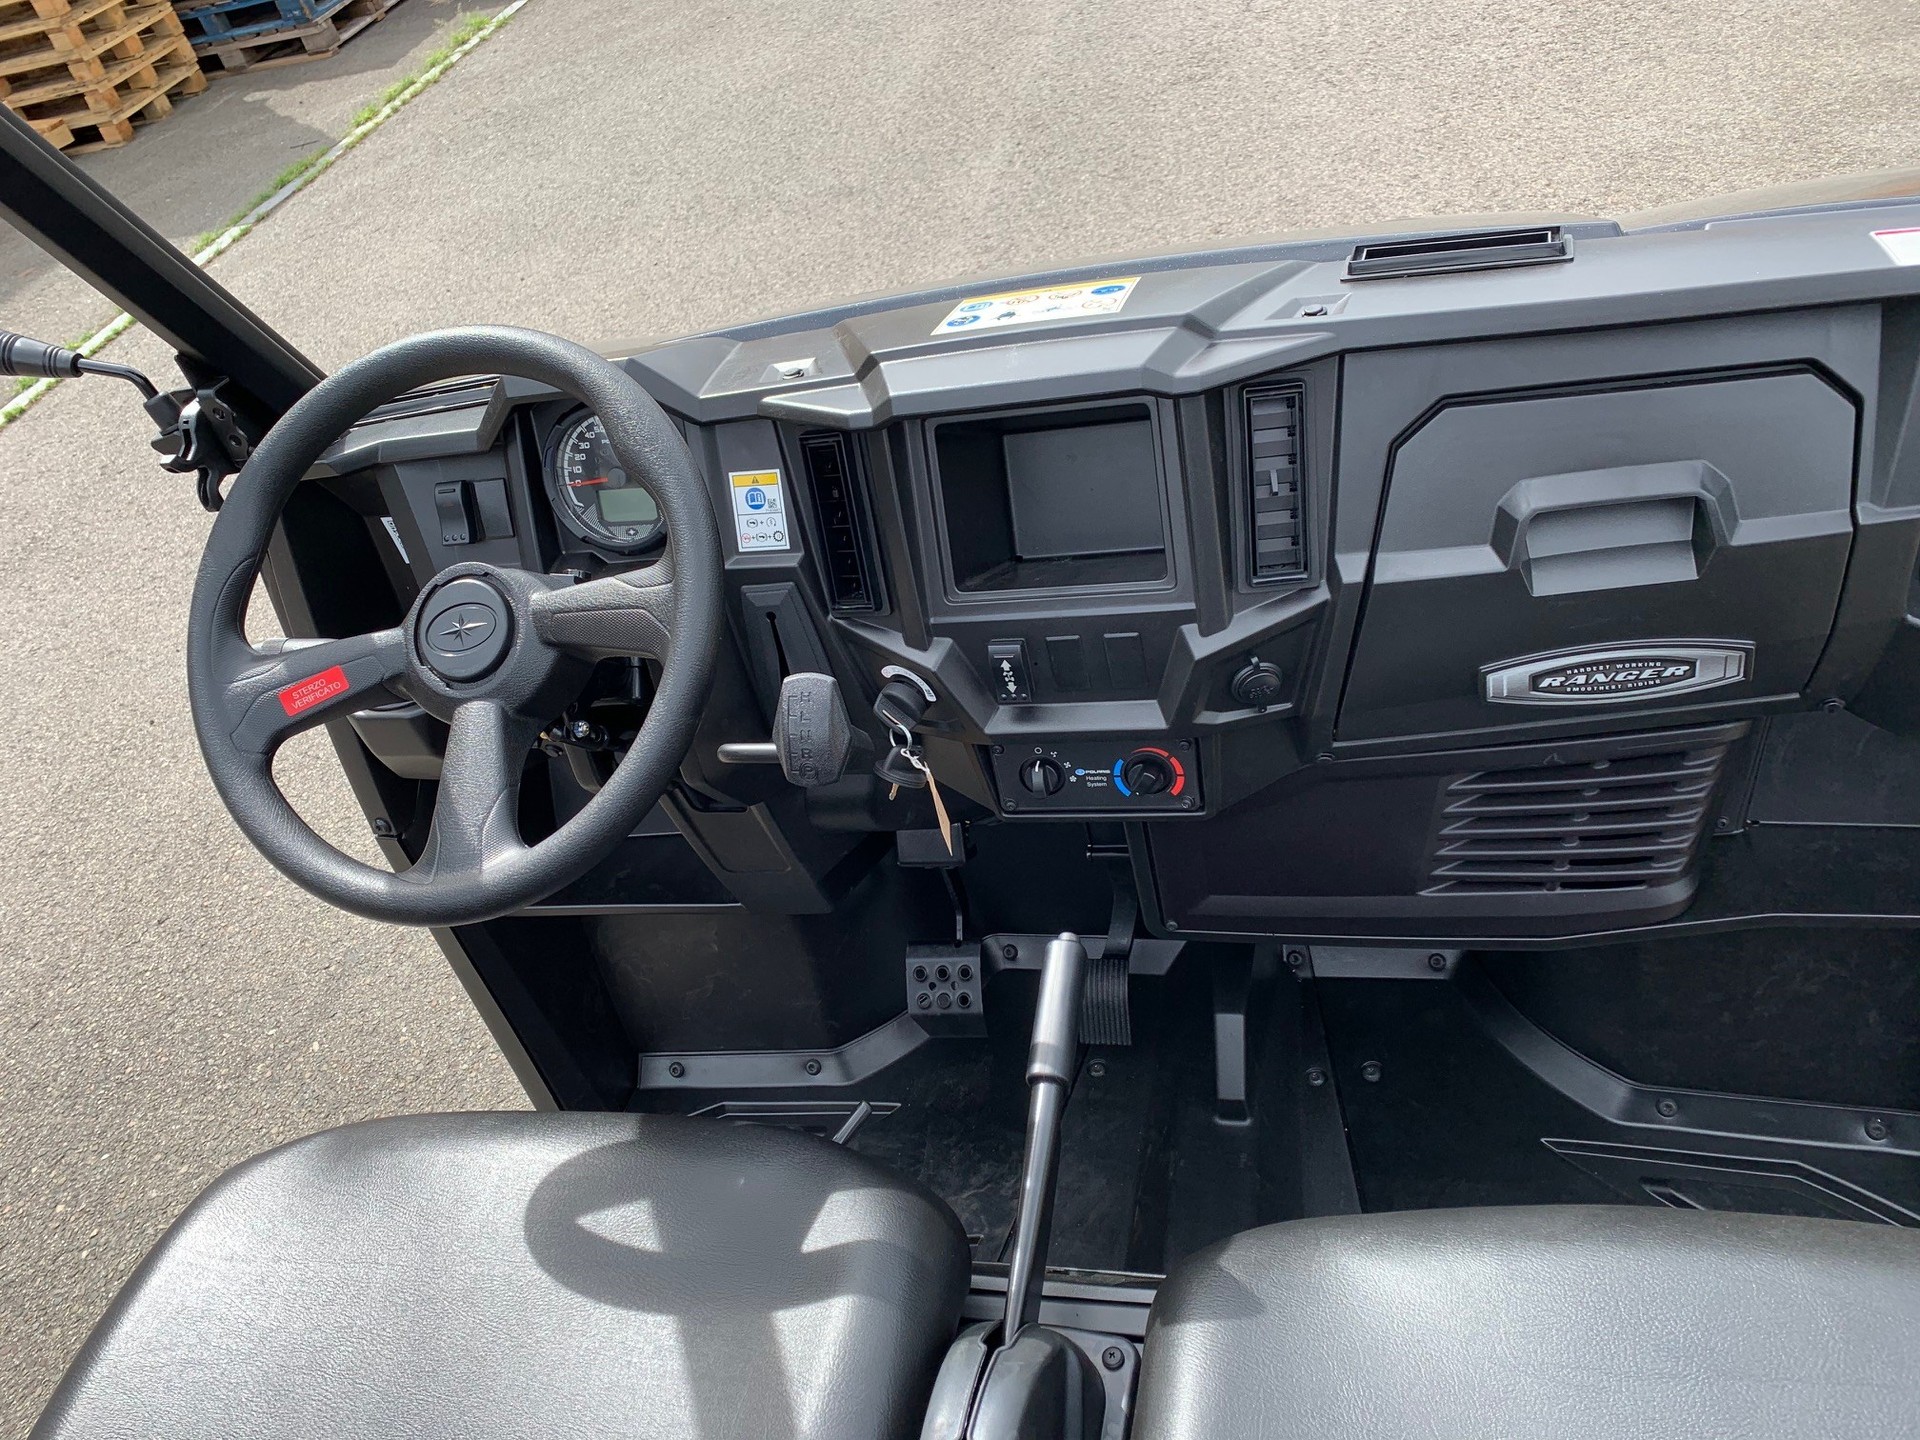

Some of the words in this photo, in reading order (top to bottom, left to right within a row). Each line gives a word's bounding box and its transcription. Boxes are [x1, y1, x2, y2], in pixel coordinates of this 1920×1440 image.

[584, 431, 596, 439] 40
[578, 442, 590, 450] 30
[574, 453, 586, 461] 20
[572, 465, 582, 474] 10
[1566, 664, 1610, 675] HARDEST
[1616, 661, 1662, 669] WORKING
[1538, 665, 1690, 688] RANGER
[292, 678, 326, 700] STERZO
[1566, 684, 1622, 692] SMOOTHEST
[1627, 679, 1661, 688] RIDING
[291, 681, 341, 709] VERIFICATO
